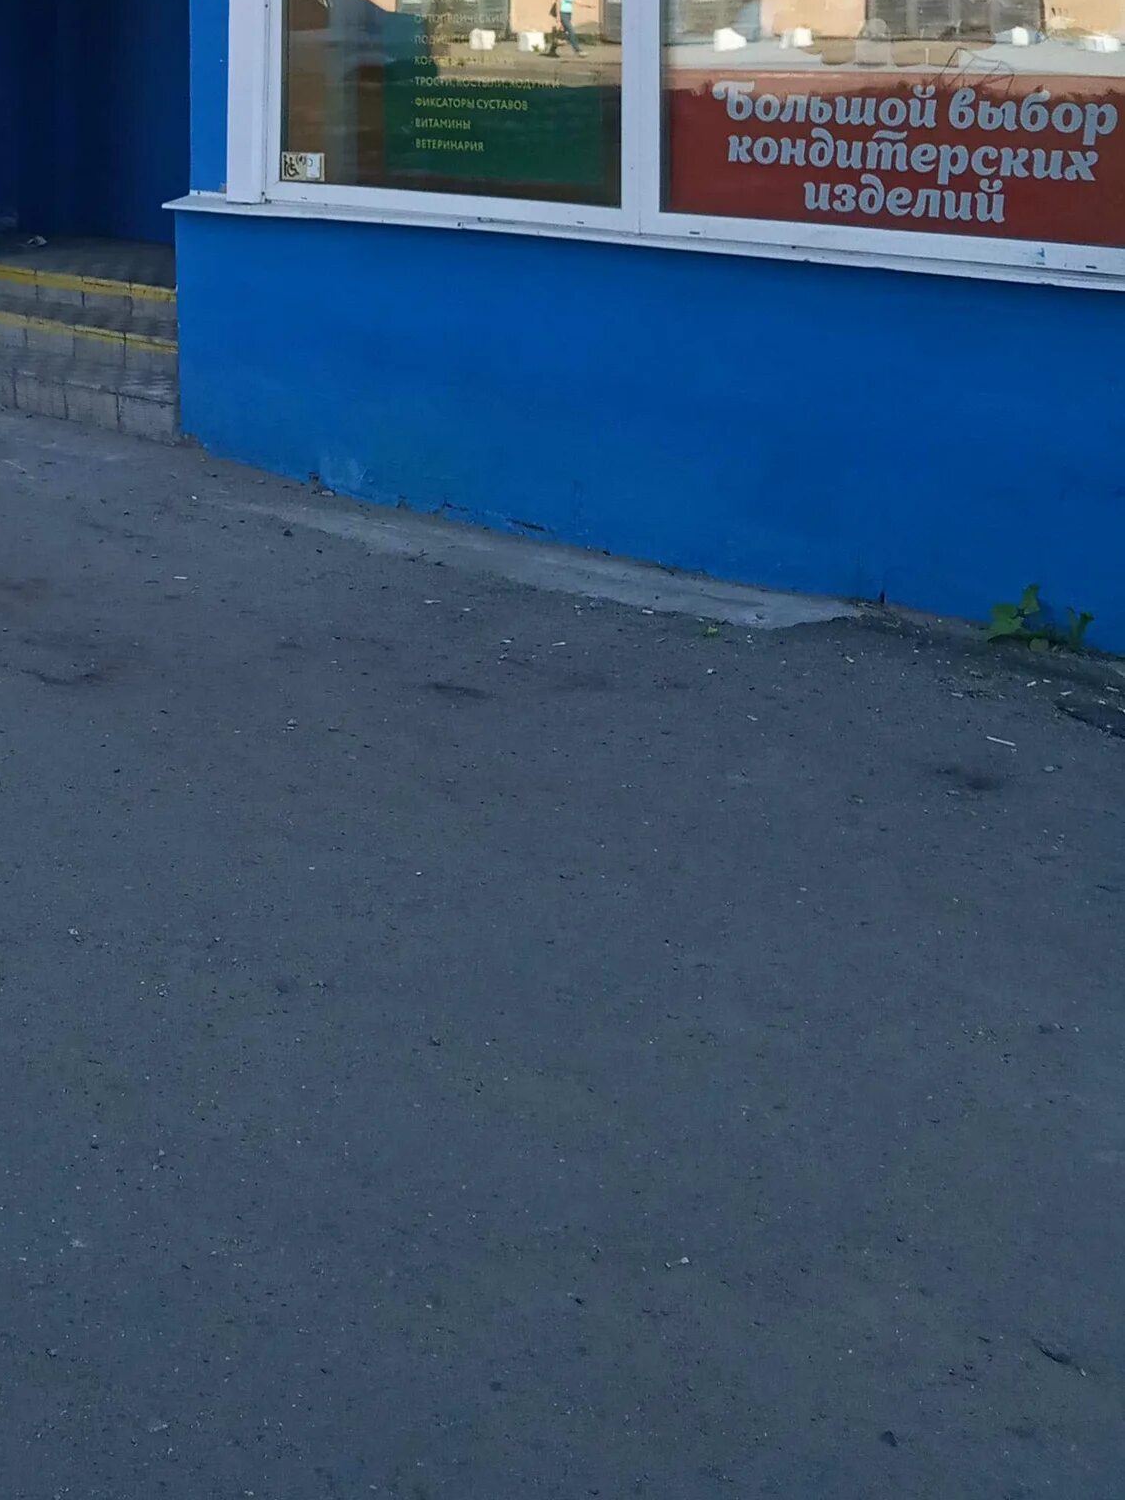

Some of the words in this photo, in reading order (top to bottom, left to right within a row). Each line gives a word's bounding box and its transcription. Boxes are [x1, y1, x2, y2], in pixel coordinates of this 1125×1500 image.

[415, 97, 475, 109] ФИКСАТОРЫ
[476, 98, 529, 111] СУСТАВОВ
[712, 79, 938, 128] Большой
[948, 87, 1118, 146] выбор
[415, 118, 471, 130] ВИТАМИНЫ
[415, 138, 485, 152] ВЕТЕРИНАРИЯ
[727, 127, 1100, 185] кондитерских
[803, 174, 1007, 224] изделий
